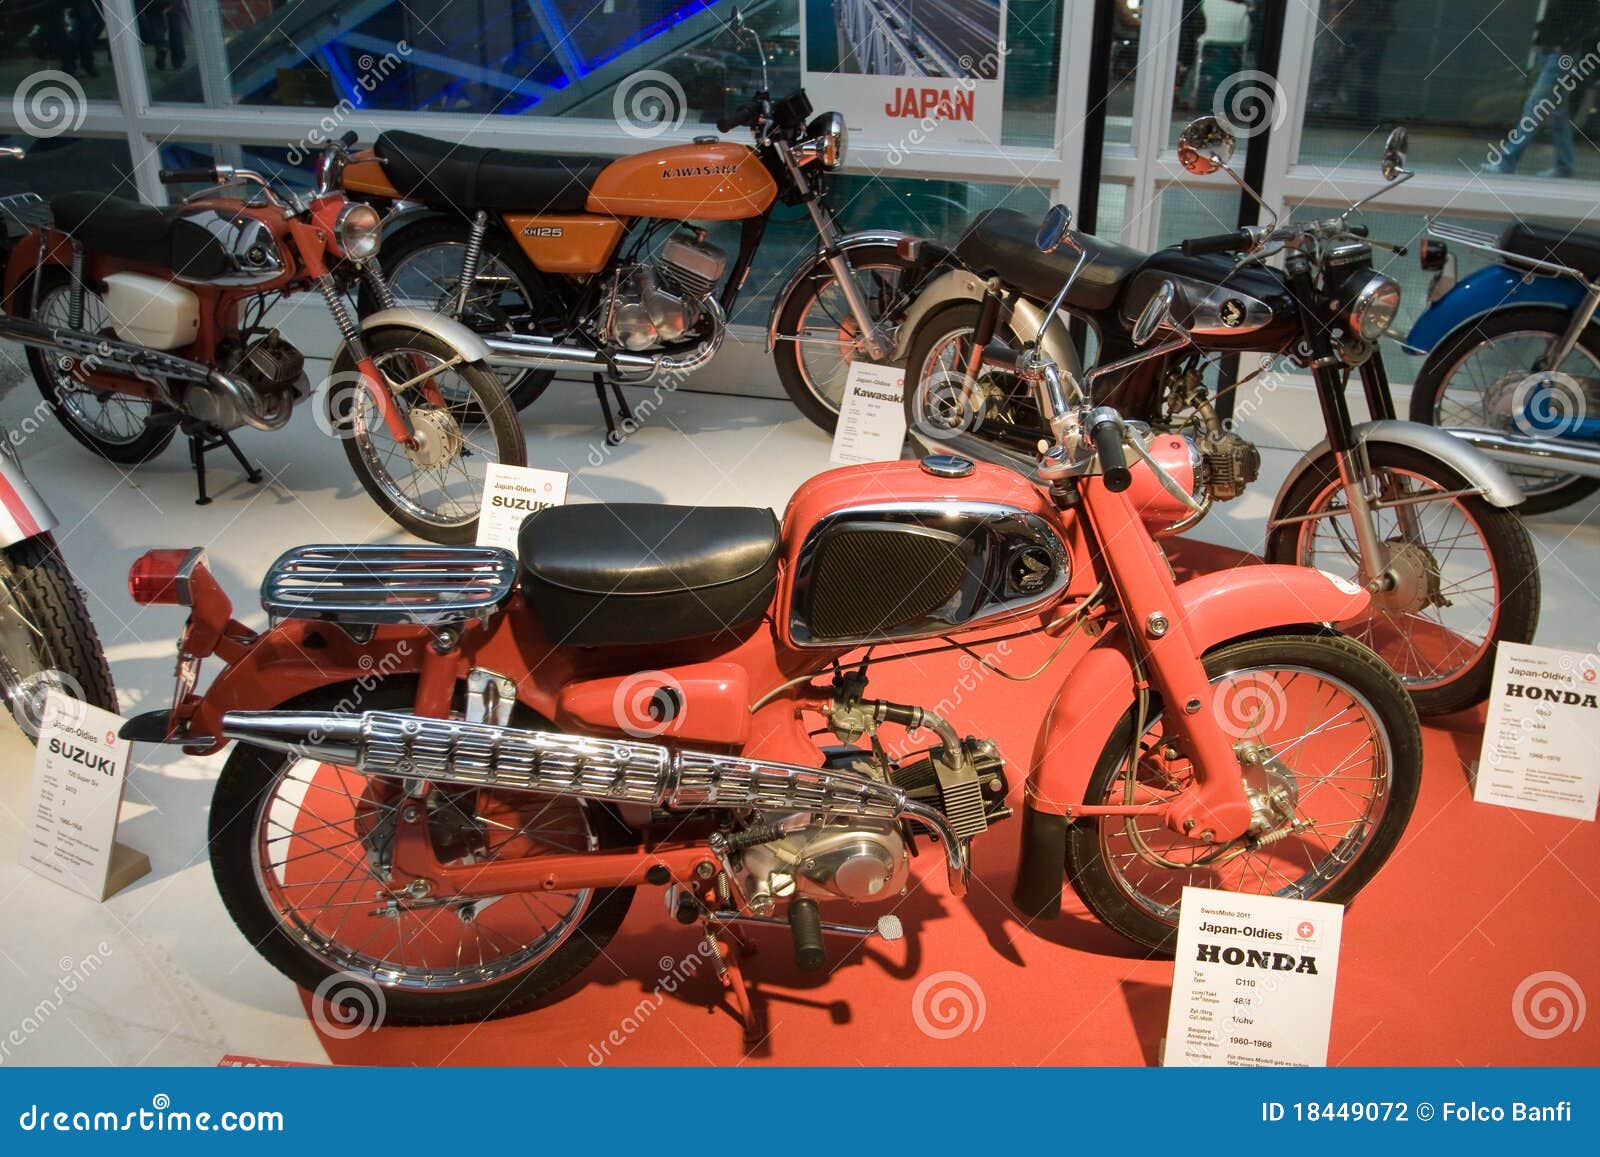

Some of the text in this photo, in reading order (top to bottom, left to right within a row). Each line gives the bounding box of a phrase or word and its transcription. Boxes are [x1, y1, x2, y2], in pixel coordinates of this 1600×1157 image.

[885, 87, 975, 122] JAPAN
[662, 164, 739, 179] KAWASAKI
[524, 228, 563, 238] KH125
[1505, 683, 1599, 709] HONDA
[48, 738, 116, 777] SUZUKI
[1200, 907, 1235, 918] SwissMoto
[1199, 921, 1283, 940] Japan-Oldies
[1196, 943, 1319, 976] HONDA
[1235, 978, 1256, 988] C110
